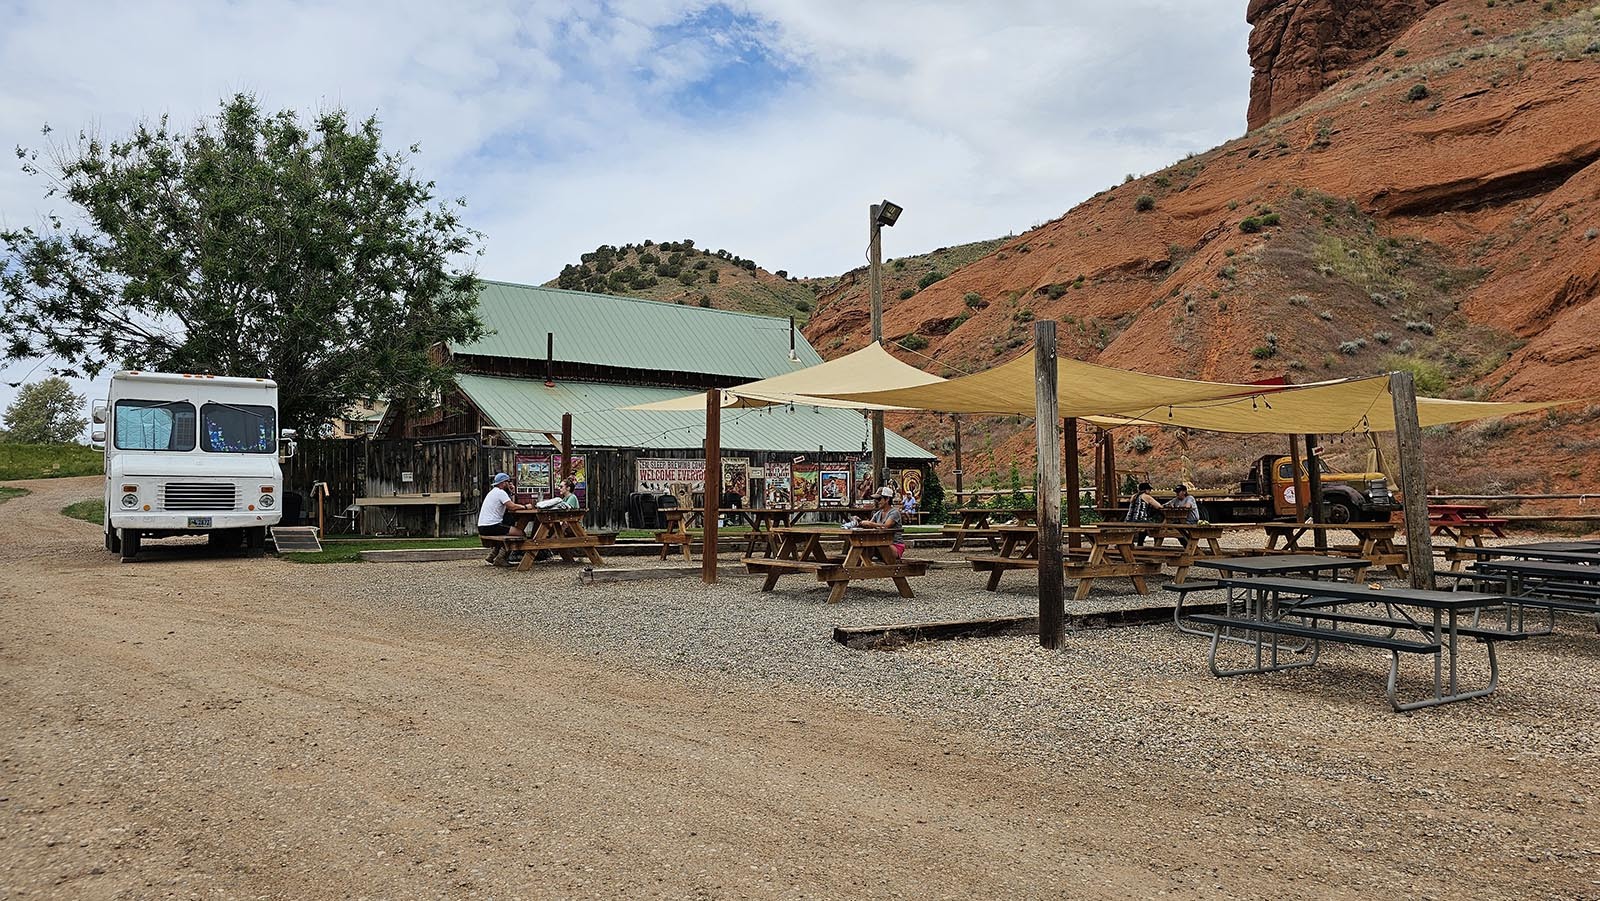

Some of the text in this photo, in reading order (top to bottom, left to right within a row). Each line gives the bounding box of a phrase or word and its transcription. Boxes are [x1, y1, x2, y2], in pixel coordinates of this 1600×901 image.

[650, 461, 666, 469] SLEEP
[668, 461, 690, 469] BREWING
[640, 469, 675, 481] WELCOME
